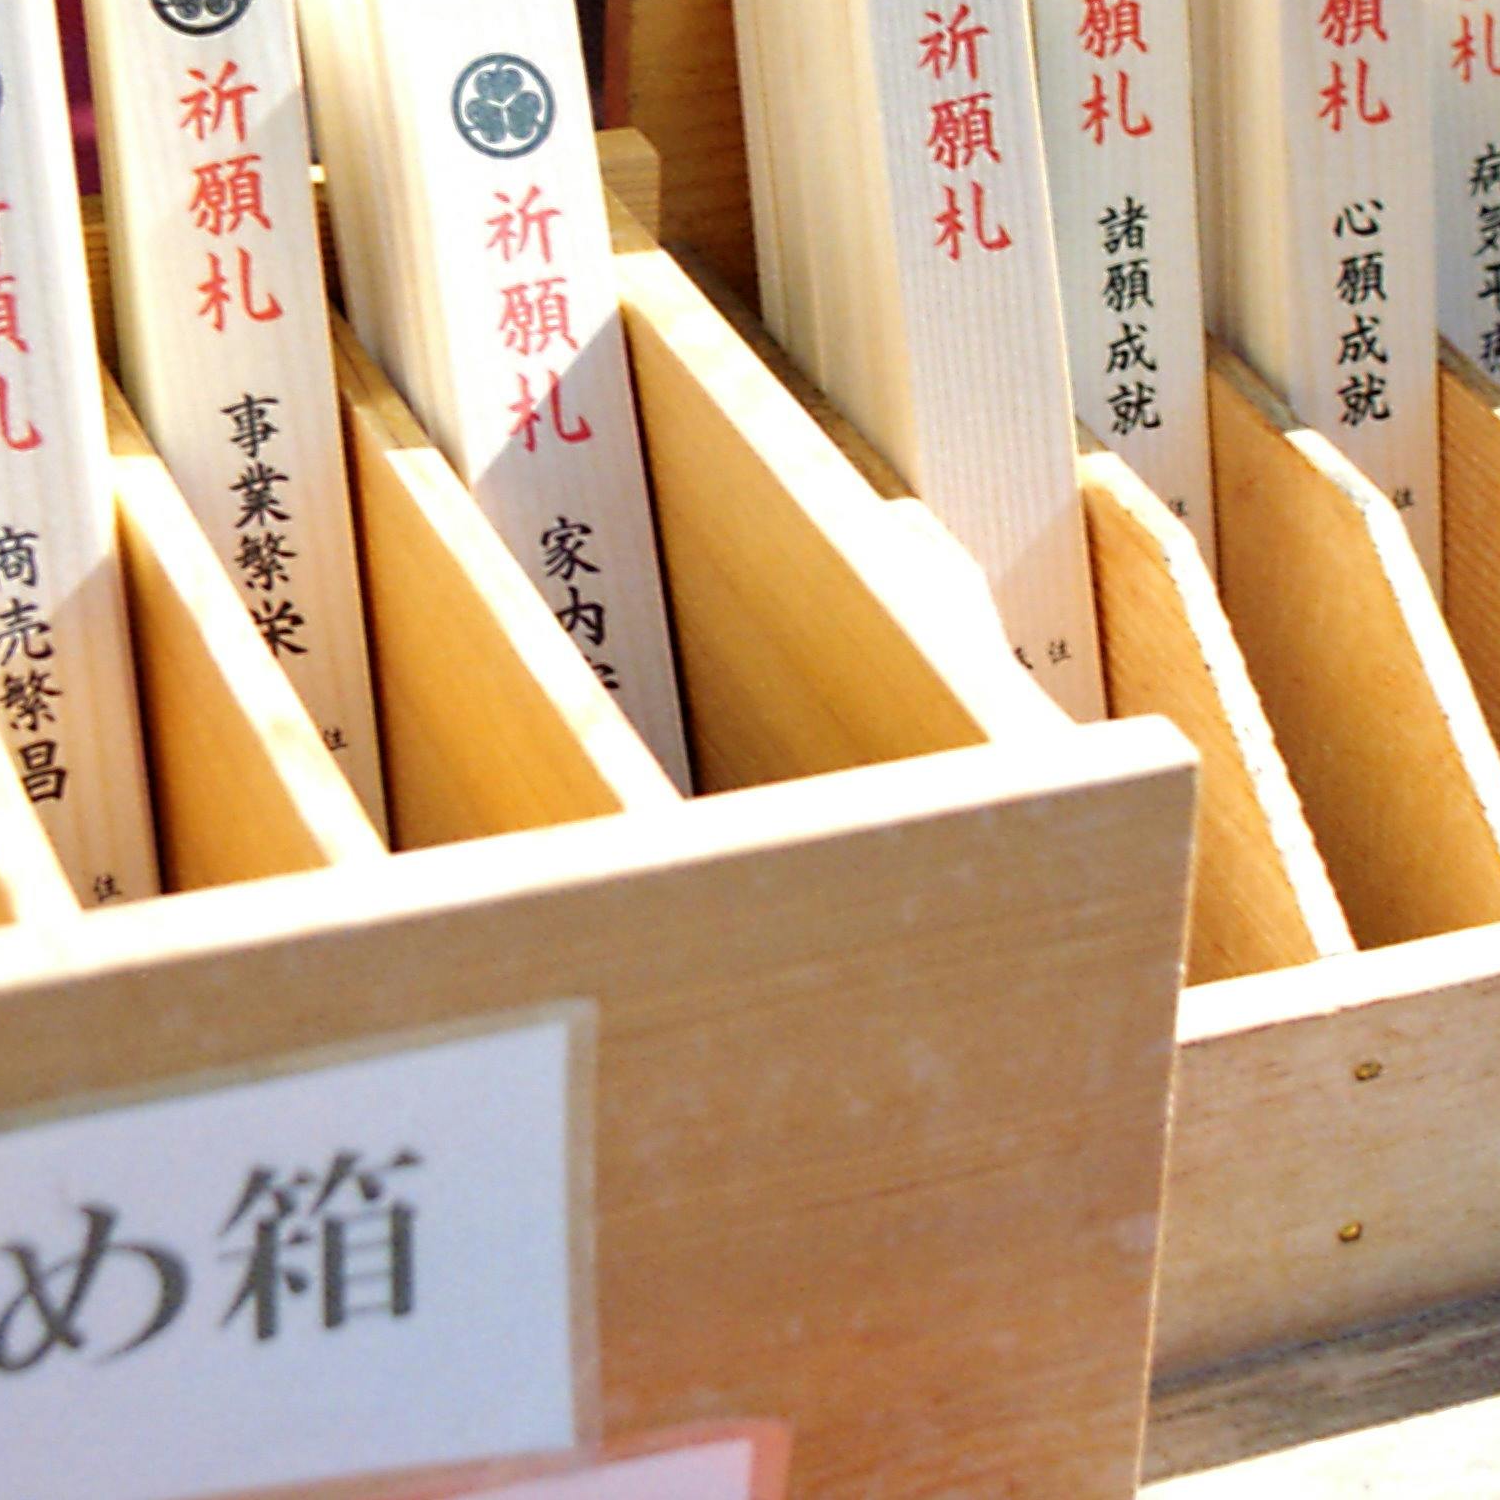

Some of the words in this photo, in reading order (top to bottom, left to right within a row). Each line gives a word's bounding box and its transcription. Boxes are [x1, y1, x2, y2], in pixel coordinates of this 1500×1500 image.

[178, 61, 283, 331] 祈願札
[917, 5, 1013, 263] 祈願札
[486, 185, 593, 453] 祈願札
[1098, 196, 1162, 436] 諸願成就
[1334, 200, 1391, 427] 心願成就
[221, 393, 308, 657] 事業繁栄
